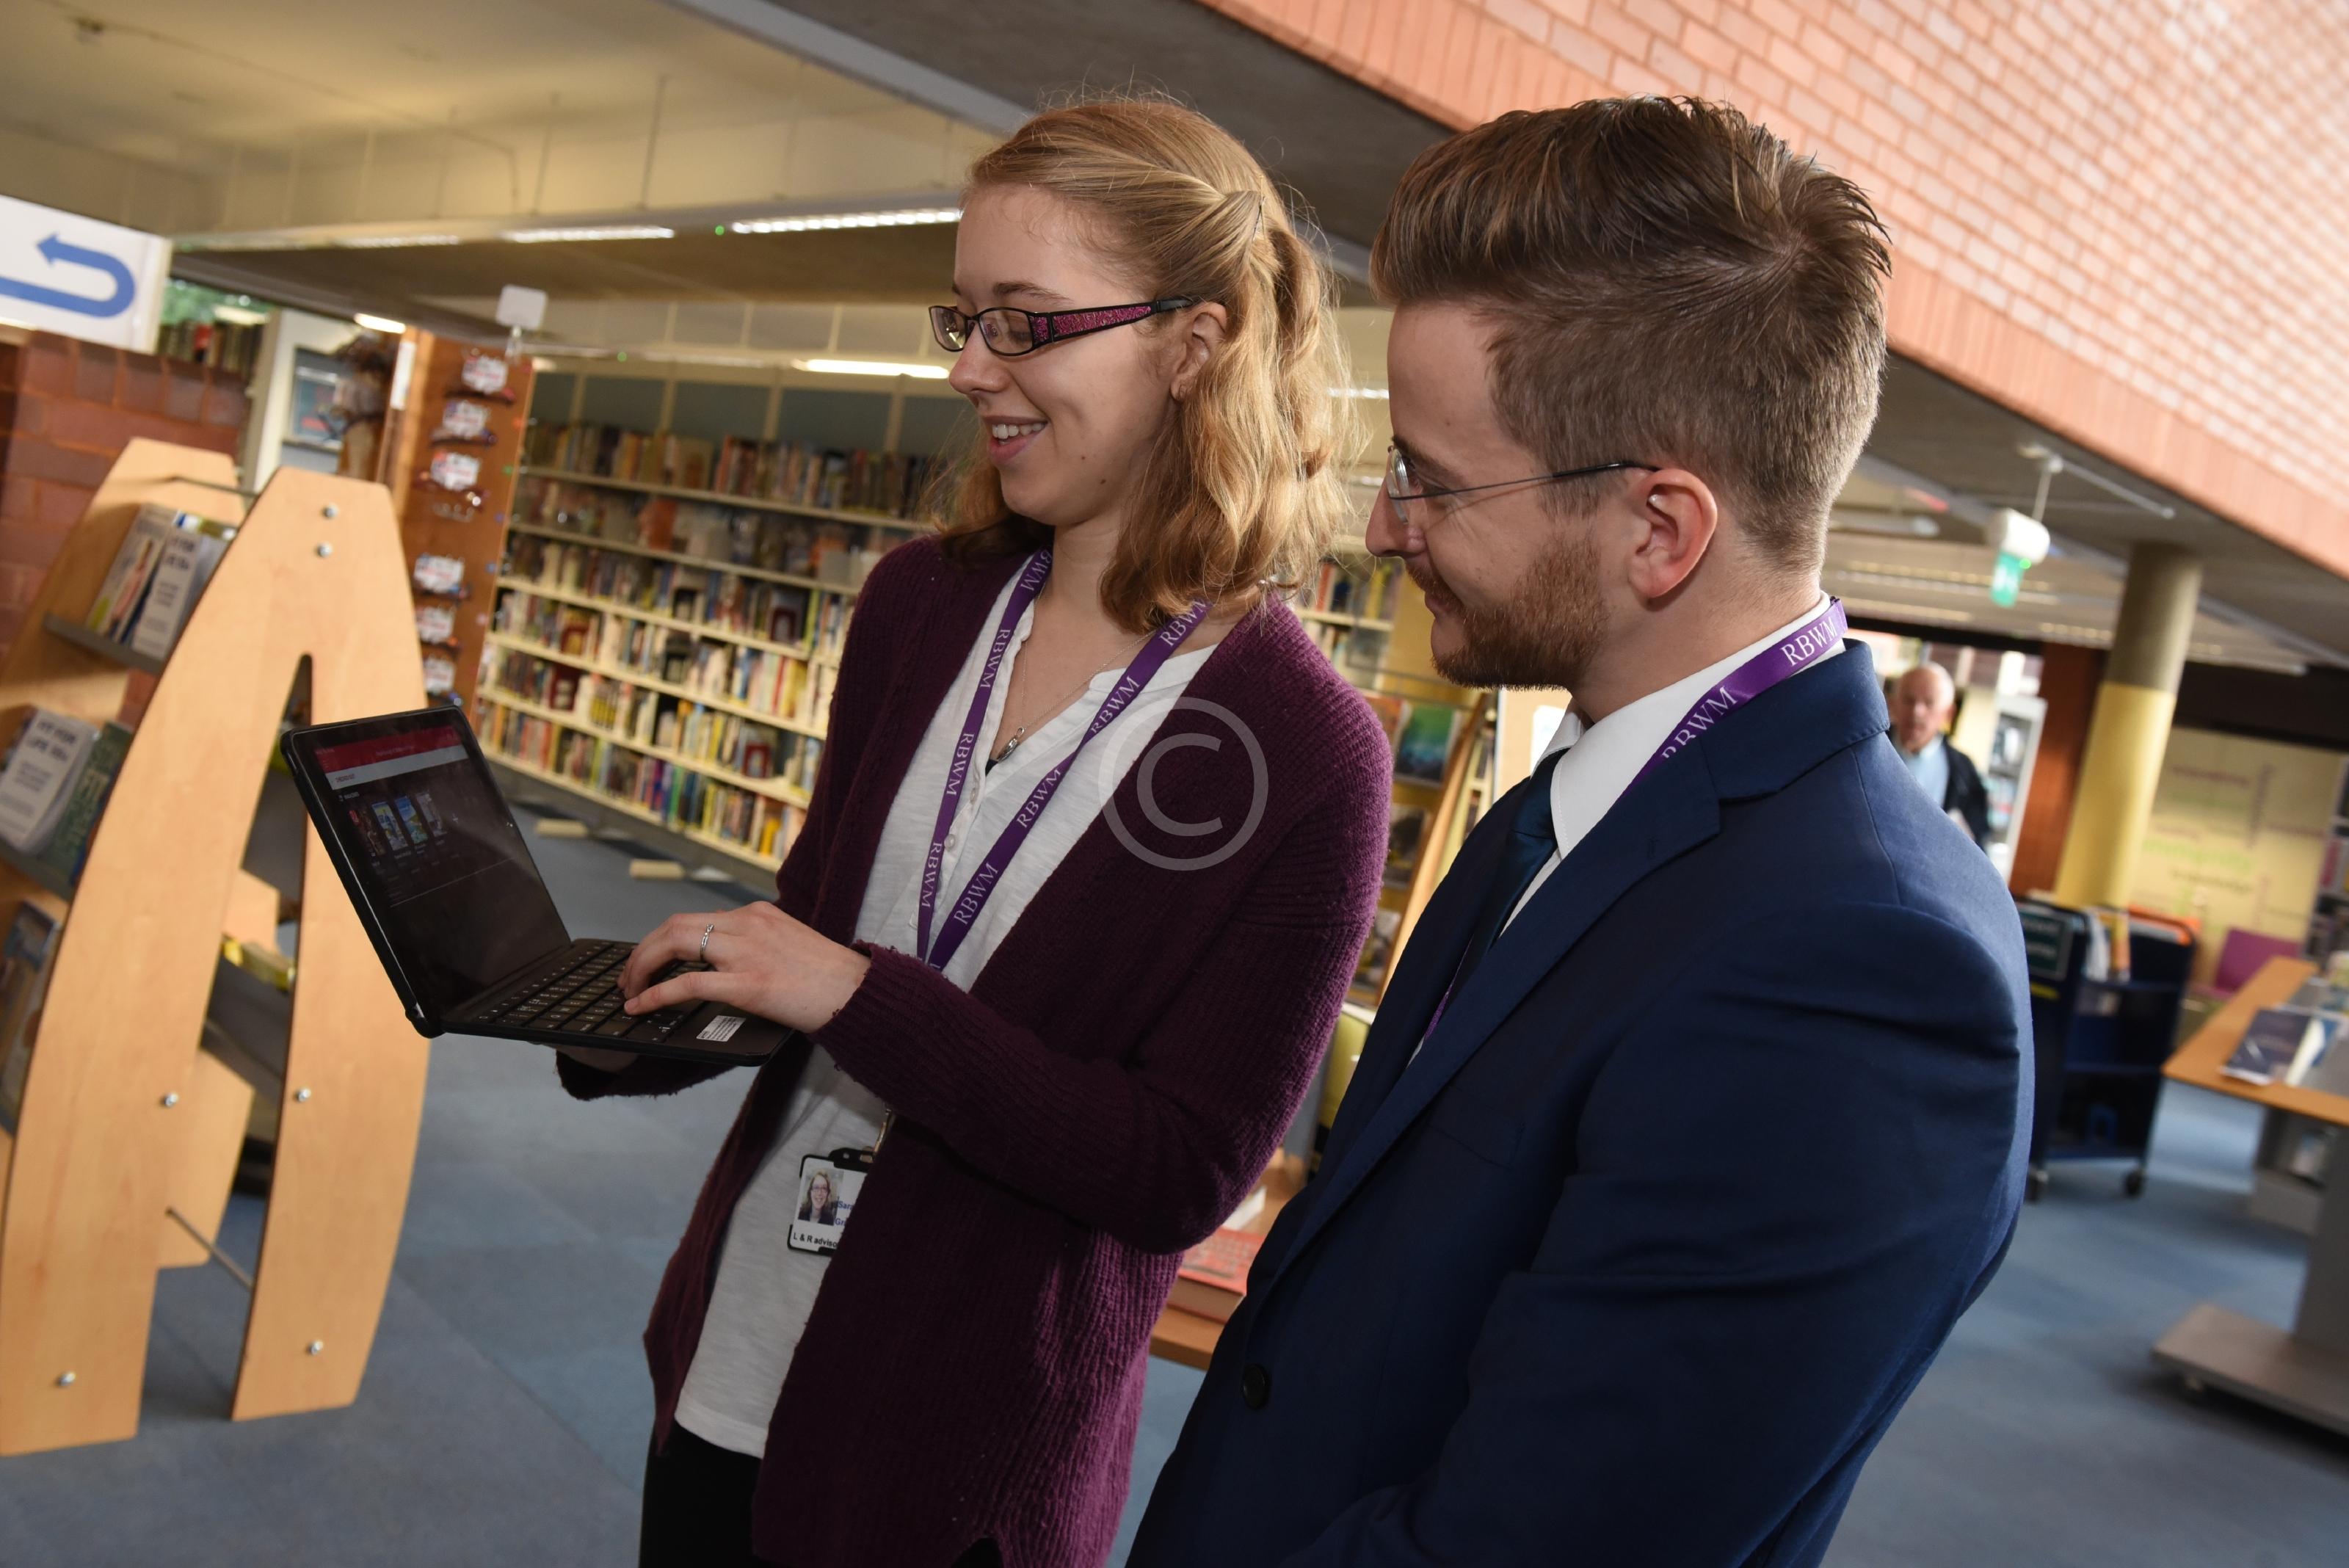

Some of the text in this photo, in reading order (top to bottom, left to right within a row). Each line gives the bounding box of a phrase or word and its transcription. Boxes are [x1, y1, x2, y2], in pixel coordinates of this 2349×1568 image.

[1020, 550, 1052, 591] BWM
[981, 629, 1011, 688] RBWM
[1780, 616, 1837, 667] RBWM
[1089, 675, 1140, 733] RBWM
[946, 733, 974, 795] RBWM
[1017, 769, 1061, 828] RBWM
[921, 843, 943, 907] RBWM
[954, 863, 998, 925] RBWM
[793, 1232, 838, 1248] L & R adviso
